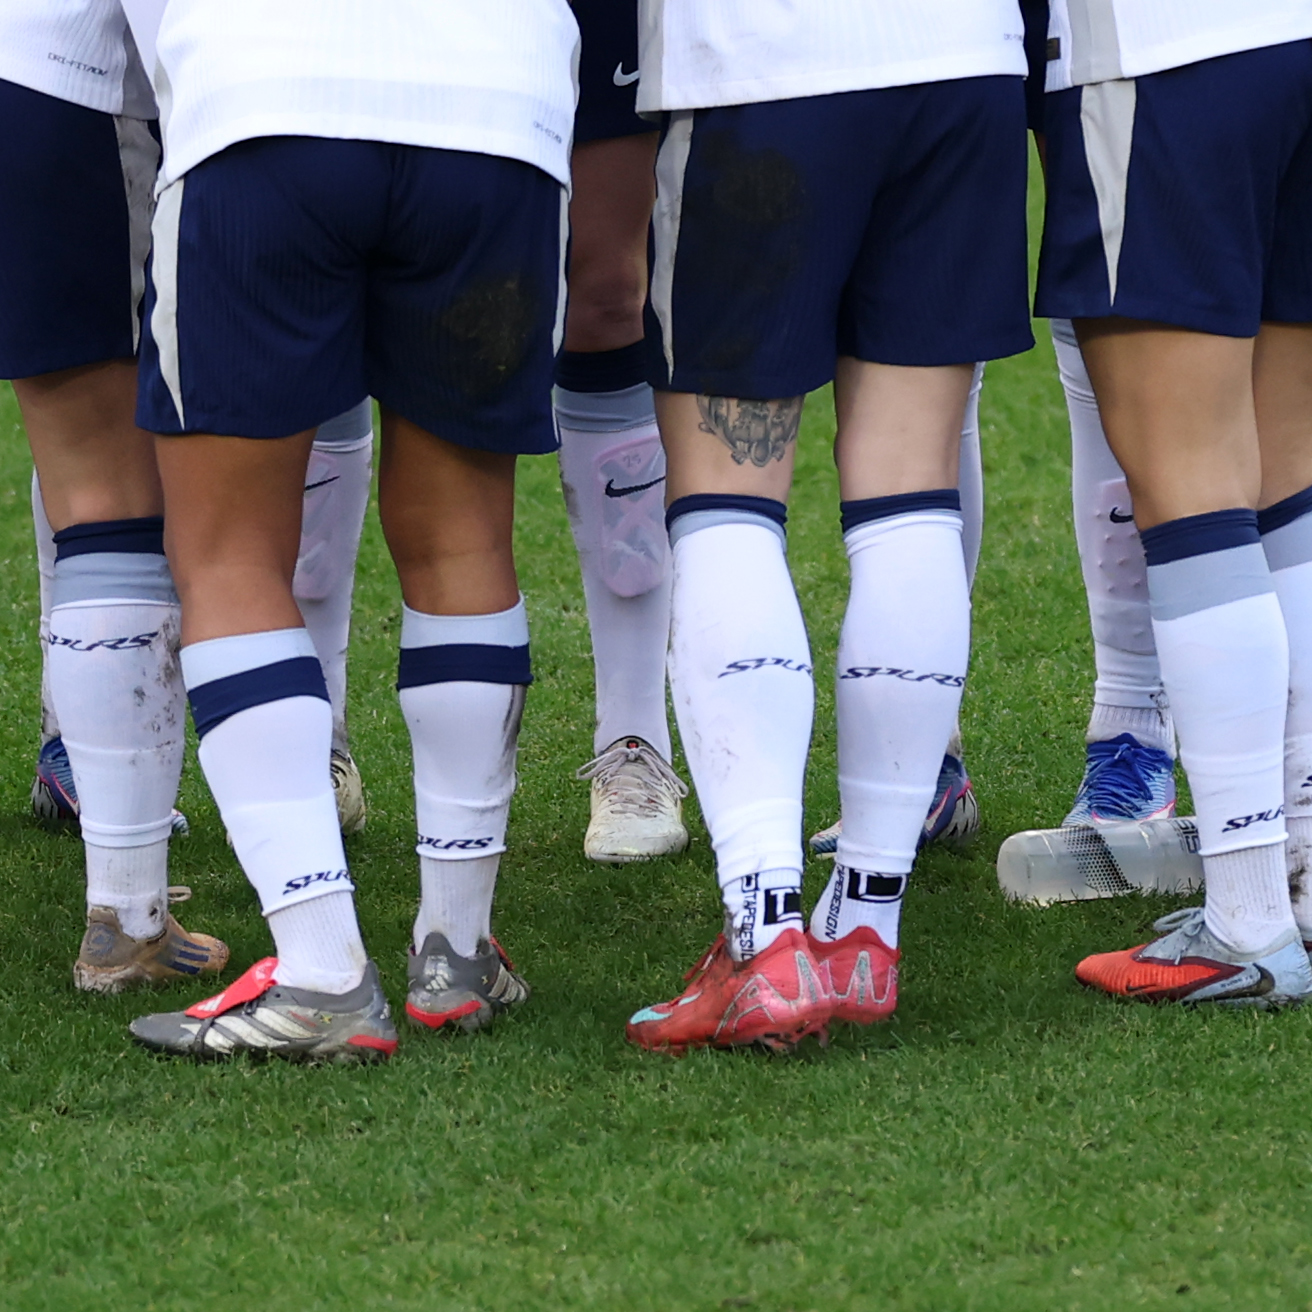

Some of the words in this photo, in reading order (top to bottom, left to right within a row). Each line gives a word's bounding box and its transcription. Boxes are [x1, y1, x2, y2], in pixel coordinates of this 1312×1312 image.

[718, 657, 813, 679] SPUR
[840, 666, 966, 688] SPURS
[1222, 804, 1285, 833] SPUR
